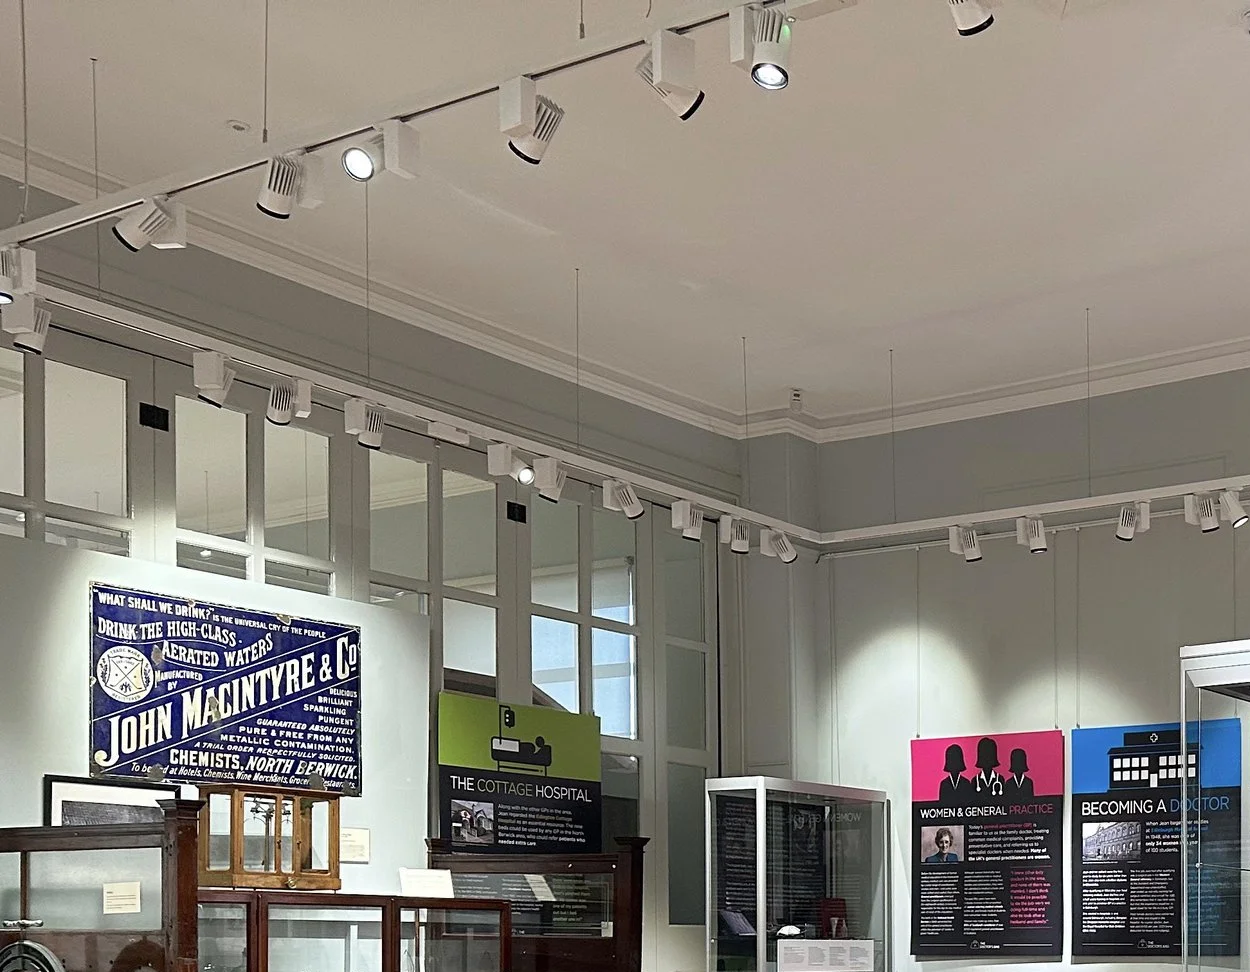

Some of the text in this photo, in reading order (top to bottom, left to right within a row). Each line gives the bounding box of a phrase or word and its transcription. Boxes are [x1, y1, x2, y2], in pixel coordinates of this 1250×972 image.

[128, 596, 158, 612] SHALL
[159, 601, 173, 615] WE
[212, 613, 220, 622] IS
[221, 615, 233, 624] THE
[234, 617, 268, 630] UNIVERSAL
[268, 622, 280, 632] CRY
[282, 625, 290, 633] OF
[291, 626, 302, 635] THE
[304, 628, 326, 639] PEOPLE
[140, 621, 163, 640] THE
[167, 621, 237, 648] HIGH-CLASS
[162, 632, 274, 668] AERATED WATERS
[155, 669, 203, 683] MANUFACTURED
[167, 680, 178, 690] BY
[318, 696, 353, 707] BRILLIANT
[329, 688, 358, 698] DELICIOUS
[94, 701, 173, 767] JOHN
[320, 654, 333, 682] &
[303, 704, 347, 716] SPARKLING
[256, 718, 356, 736] GUARANTEED ABSOLUTELY
[318, 716, 354, 726] PUNGENT
[220, 734, 355, 754] METALLIC CONTAMINATION.
[239, 726, 354, 744] PURE & FREE FROM ANY
[202, 742, 225, 750] TRIAL
[226, 745, 254, 754] ORDER
[256, 747, 318, 759] RESPECTFULLY
[318, 754, 356, 762] SOLICITED.
[131, 762, 140, 772] To
[169, 766, 178, 776] at
[236, 770, 252, 780] Wine
[169, 748, 244, 771] CHEMISTS,
[244, 755, 295, 774] NORTH
[294, 760, 358, 780] BERWICK.
[450, 776, 592, 802] THE COTTAGE HOSPITAL
[920, 804, 1054, 819] WOMEN & GENERAL PRACTICE
[1081, 796, 1230, 816] BECOMING A DOCTOR
